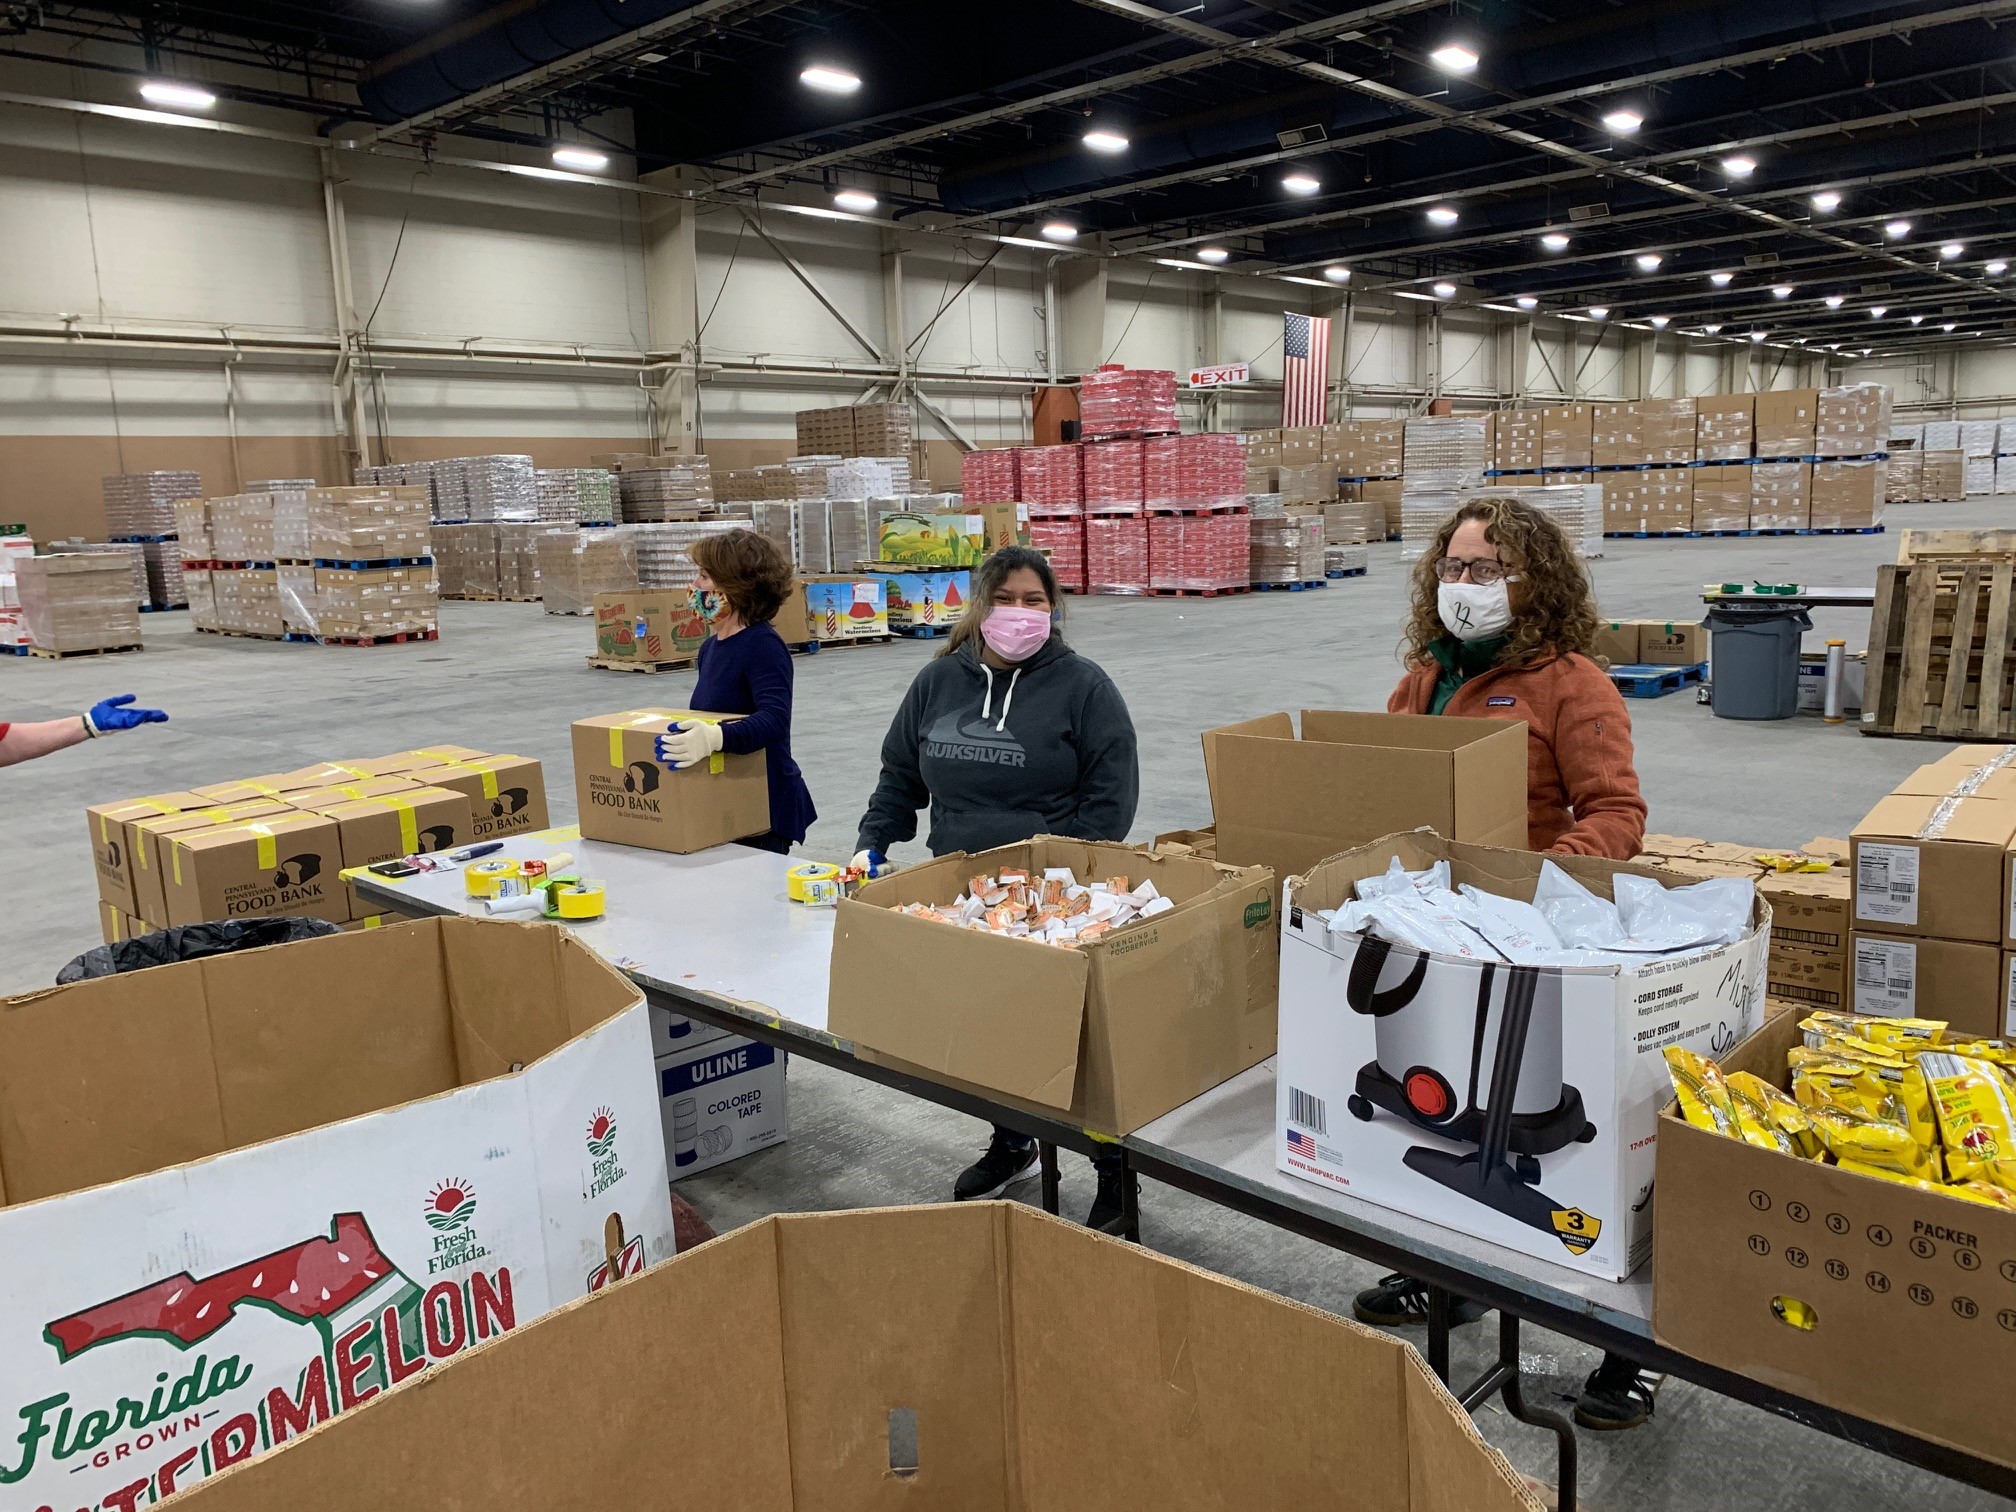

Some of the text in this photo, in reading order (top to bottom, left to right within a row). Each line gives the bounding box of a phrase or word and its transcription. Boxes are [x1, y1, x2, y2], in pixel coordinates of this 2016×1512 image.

[1201, 369, 1247, 384] EXIT
[1800, 667, 1812, 675] NE
[926, 741, 1026, 767] QUIKSILVER
[589, 774, 611, 783] CENTRAL
[590, 783, 625, 793] PENNSYLVANIA
[591, 791, 661, 813] FOOD BANK
[473, 813, 530, 836] OD BANK
[368, 852, 397, 864] CENTRAL
[224, 882, 257, 895] CENTRAL
[225, 886, 277, 902] PENNSYLVANIA
[227, 883, 323, 916] FOOD BANK
[1110, 928, 1159, 950] VENDING &
[1110, 936, 1160, 957] FOODSERVICE
[1638, 966, 1654, 979] Attach
[1654, 965, 1666, 974] hose
[1666, 962, 1672, 971] to
[1672, 958, 1688, 971] quickly
[1638, 983, 1684, 1004] CORD STORAGE
[1638, 991, 1700, 1016] Keeps cord neatly organized
[1637, 1020, 1680, 1042] DOLLY SYSTEM
[1637, 1042, 1653, 1054] Makes
[1654, 1040, 1662, 1048] vac
[1663, 1036, 1676, 1046] mobile
[1685, 1028, 1695, 1038] easy
[1696, 1026, 1700, 1034] to
[1700, 1022, 1711, 1031] move
[691, 1050, 747, 1083] ULINE
[707, 1089, 762, 1115] COLORED
[738, 1102, 762, 1120] TAPE
[1645, 1134, 1656, 1146] OVE
[592, 1150, 618, 1178] Fresh
[1288, 1158, 1350, 1186] WWW.SHOPVAC.COM
[590, 1166, 624, 1200] Florida
[1567, 1212, 1584, 1230] 3
[432, 1226, 477, 1252] Fresh
[1561, 1232, 1591, 1244] WARRANTY
[1913, 1219, 1978, 1249] PACKER
[427, 1244, 486, 1274] Florida
[1752, 1236, 2016, 1329] 11 12 13 14 15 16 17
[0, 1354, 254, 1484] Florida
[91, 1414, 201, 1469] GROWN
